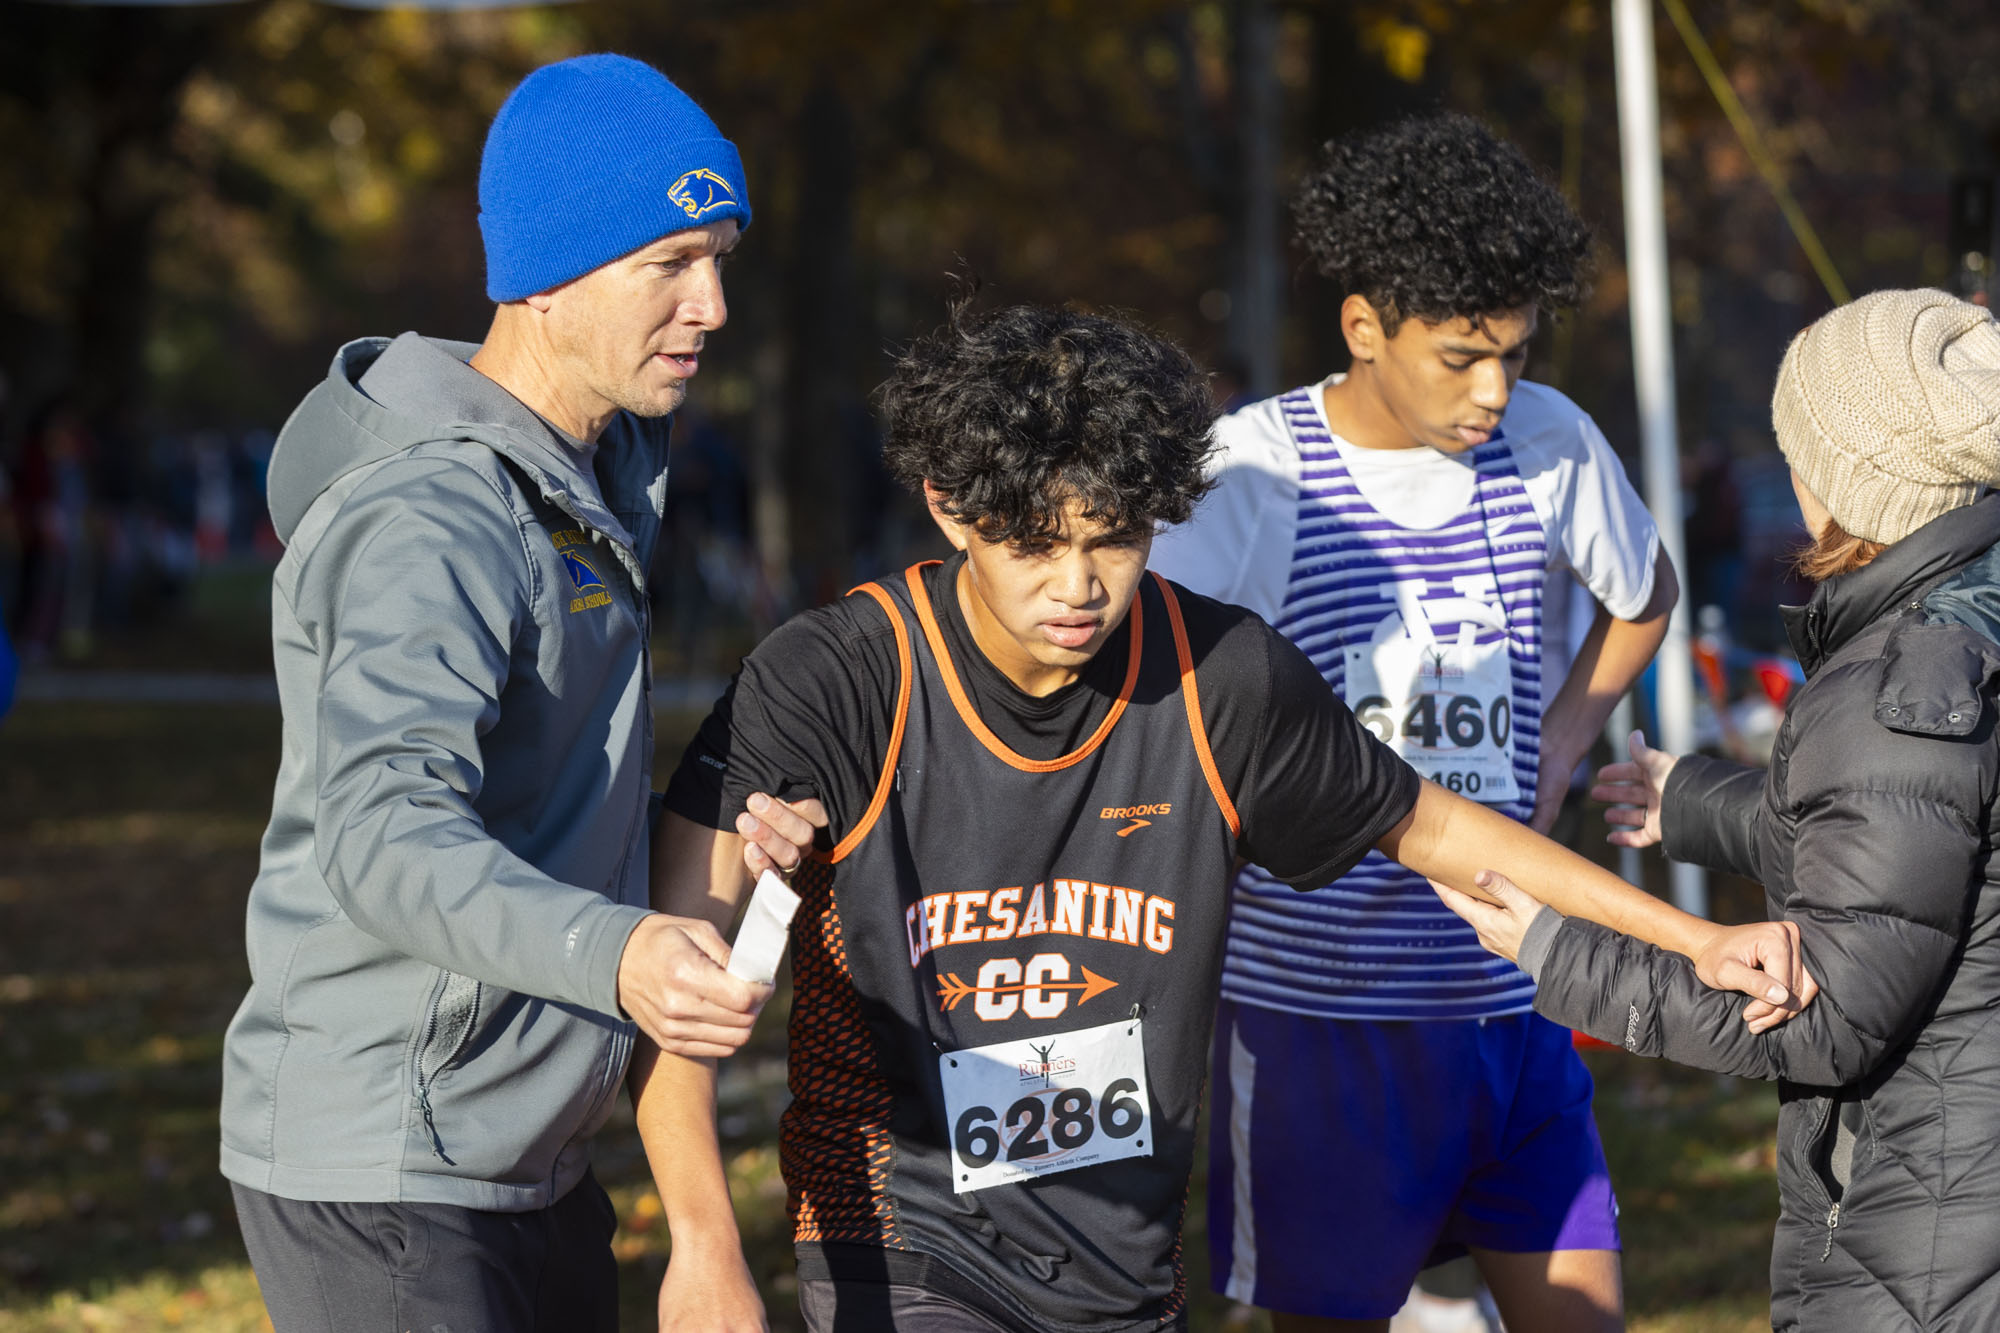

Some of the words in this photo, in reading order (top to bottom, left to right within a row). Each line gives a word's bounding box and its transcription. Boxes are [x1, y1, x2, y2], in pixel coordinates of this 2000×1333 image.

[1352, 693, 1511, 749] 6460
[1100, 803, 1172, 819] BROOKS
[906, 878, 1176, 968] CHESANING
[974, 952, 1071, 1022] CC
[1018, 1058, 1076, 1077] Runners
[955, 1077, 1144, 1169] 6286
